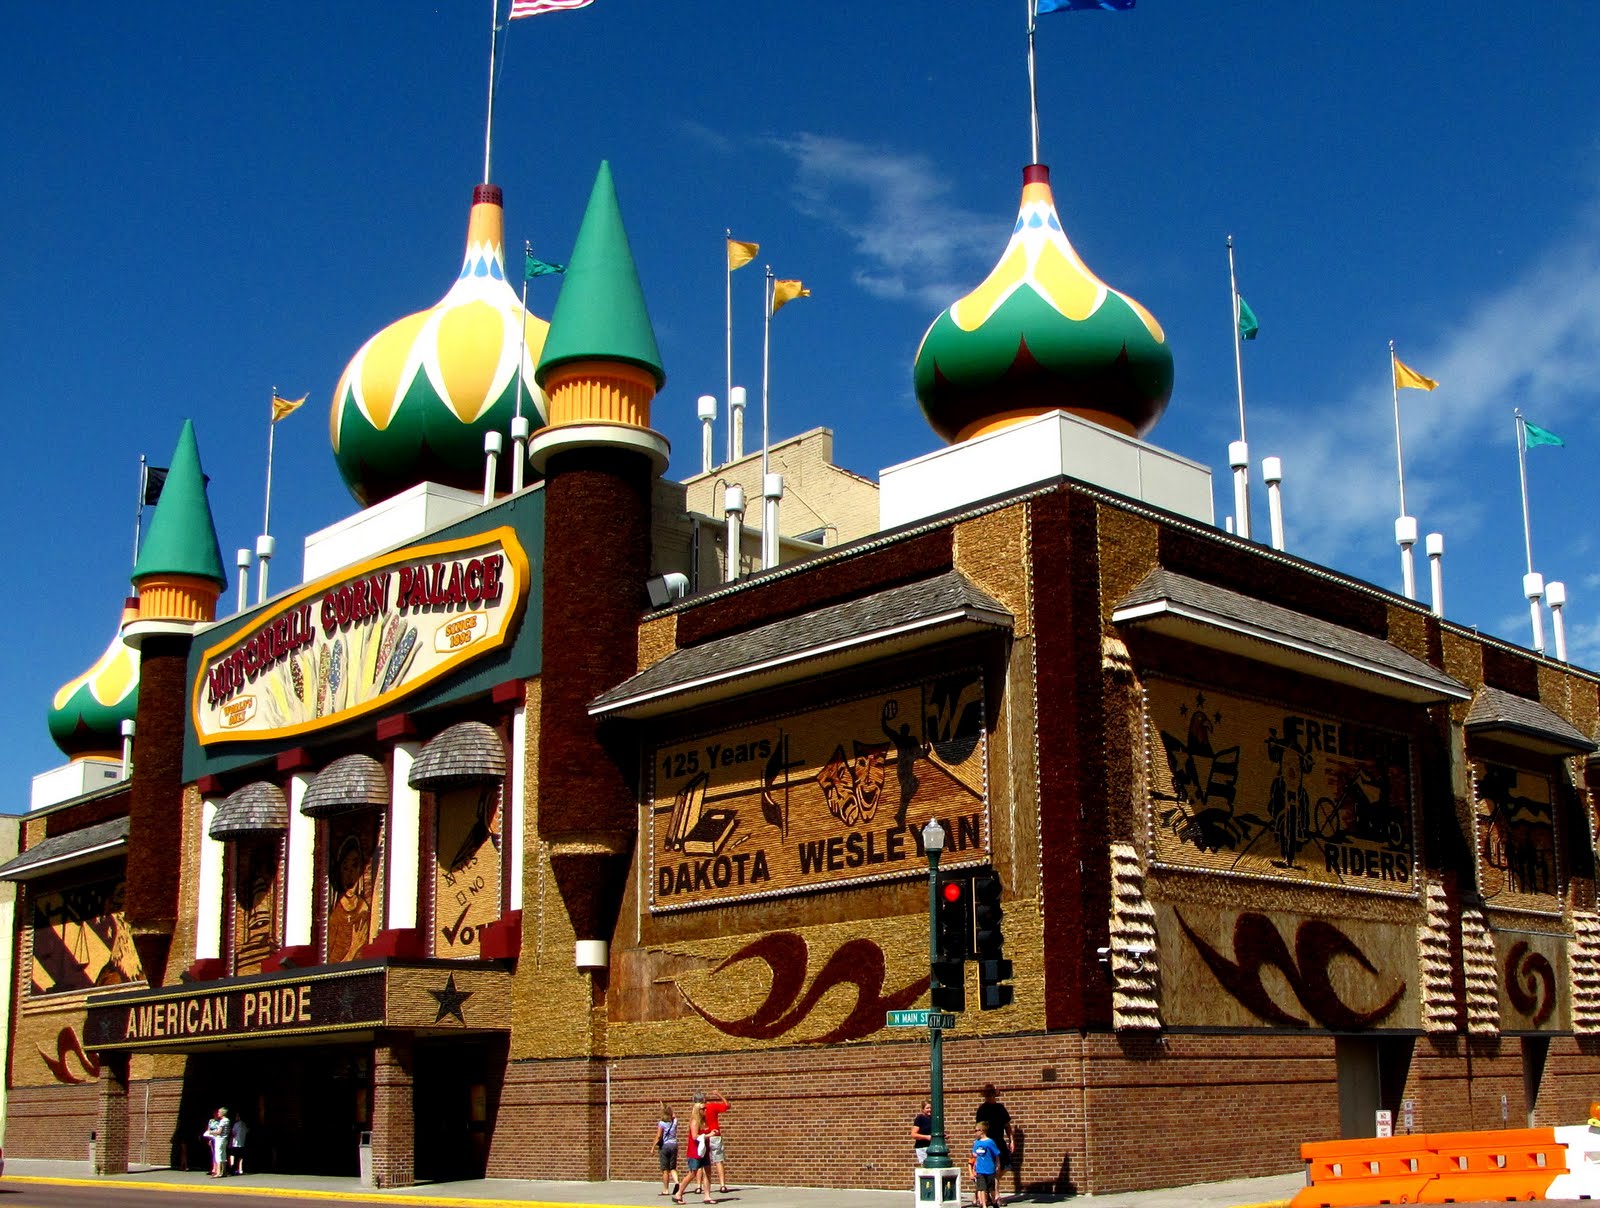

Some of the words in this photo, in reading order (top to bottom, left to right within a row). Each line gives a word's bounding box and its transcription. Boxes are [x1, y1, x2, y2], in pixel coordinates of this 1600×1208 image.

[208, 604, 314, 706] MITCHELL
[320, 572, 391, 632] CORN
[397, 553, 504, 608] PALACE
[446, 615, 477, 637] SINCE
[450, 630, 471, 648] 1892
[662, 752, 699, 779] 125
[706, 739, 771, 769] Years
[658, 850, 770, 896] DAKOTA
[1325, 844, 1409, 883] RIDERS
[469, 876, 485, 897] NO
[126, 997, 228, 1038] AMERICAN
[244, 986, 311, 1027] PRIDE
[894, 1013, 900, 1024] N
[902, 1013, 918, 1023] MAIN
[921, 1012, 929, 1023] ST
[929, 1016, 941, 1027] 6TH
[942, 1016, 954, 1027] AVE
